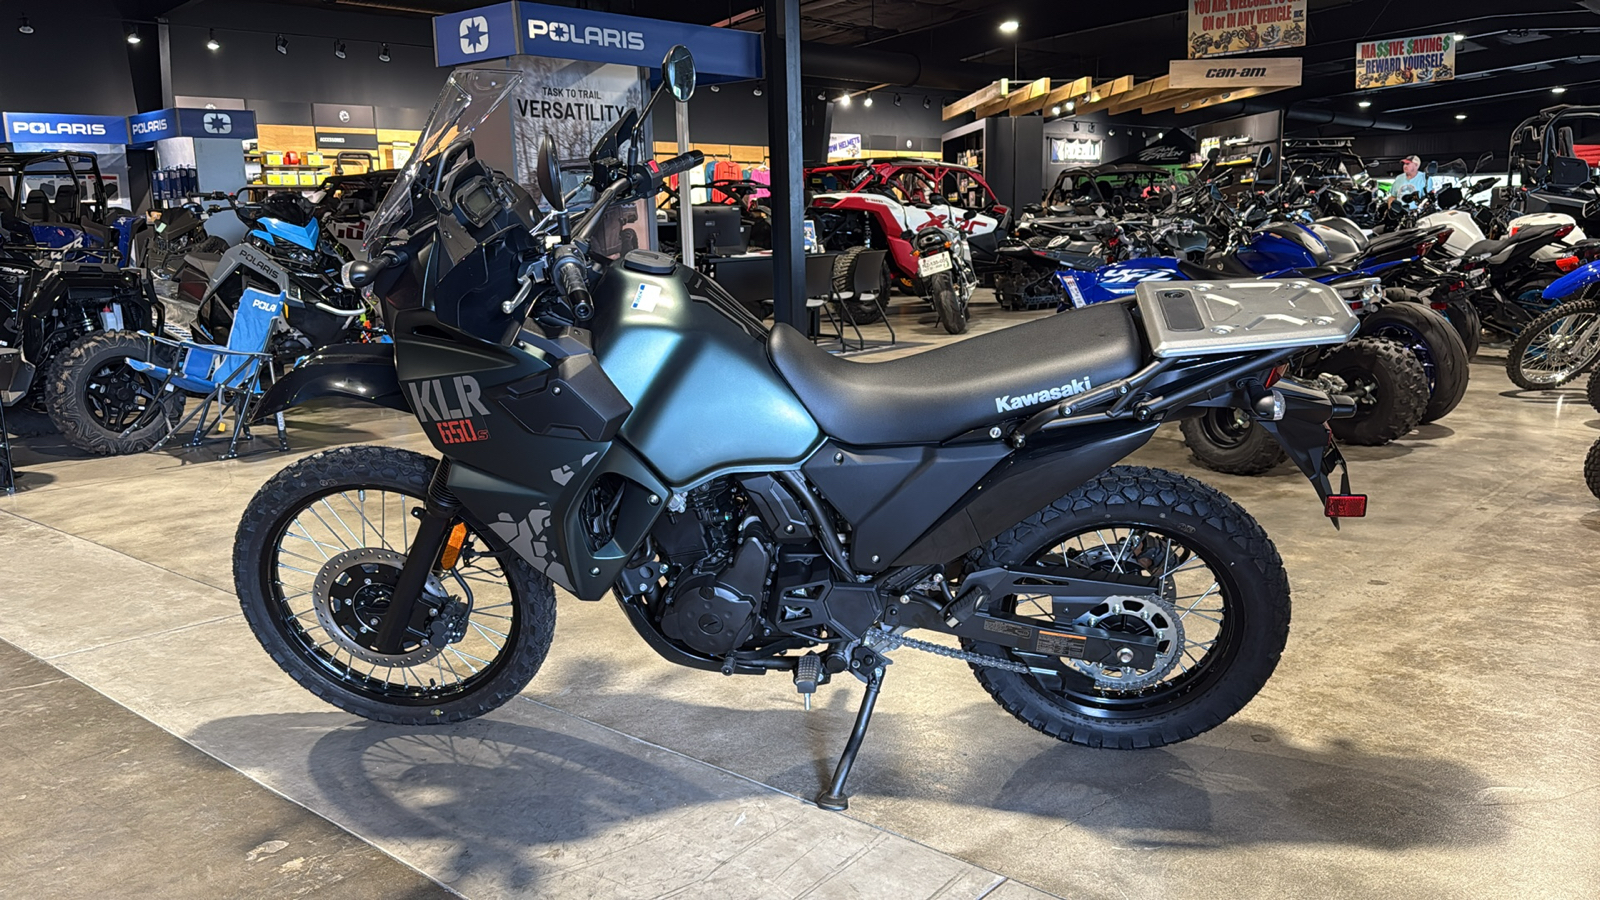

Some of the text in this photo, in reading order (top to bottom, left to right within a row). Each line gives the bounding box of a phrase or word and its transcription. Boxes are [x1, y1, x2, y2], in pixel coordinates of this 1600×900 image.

[1194, 0, 1210, 15] YOU
[1212, 0, 1228, 13] ARE
[1202, 16, 1214, 31] ON
[1227, 13, 1236, 28] IN
[1237, 10, 1255, 27] ANY
[1256, 5, 1292, 24] VEHICLE
[527, 19, 645, 51] POLARIS
[1205, 67, 1267, 78] can-am
[1365, 57, 1401, 75] REWARD
[1403, 52, 1444, 70] YOURSELF
[542, 86, 602, 99] TASK TO TRAIL
[517, 99, 625, 122] VERSATILITY
[13, 121, 106, 135] POLARIS
[132, 118, 168, 135] POLARIS
[238, 250, 280, 279] POLARIS
[252, 299, 277, 312] POLA
[408, 375, 491, 423] KLR
[995, 376, 1092, 413] Kawasaki
